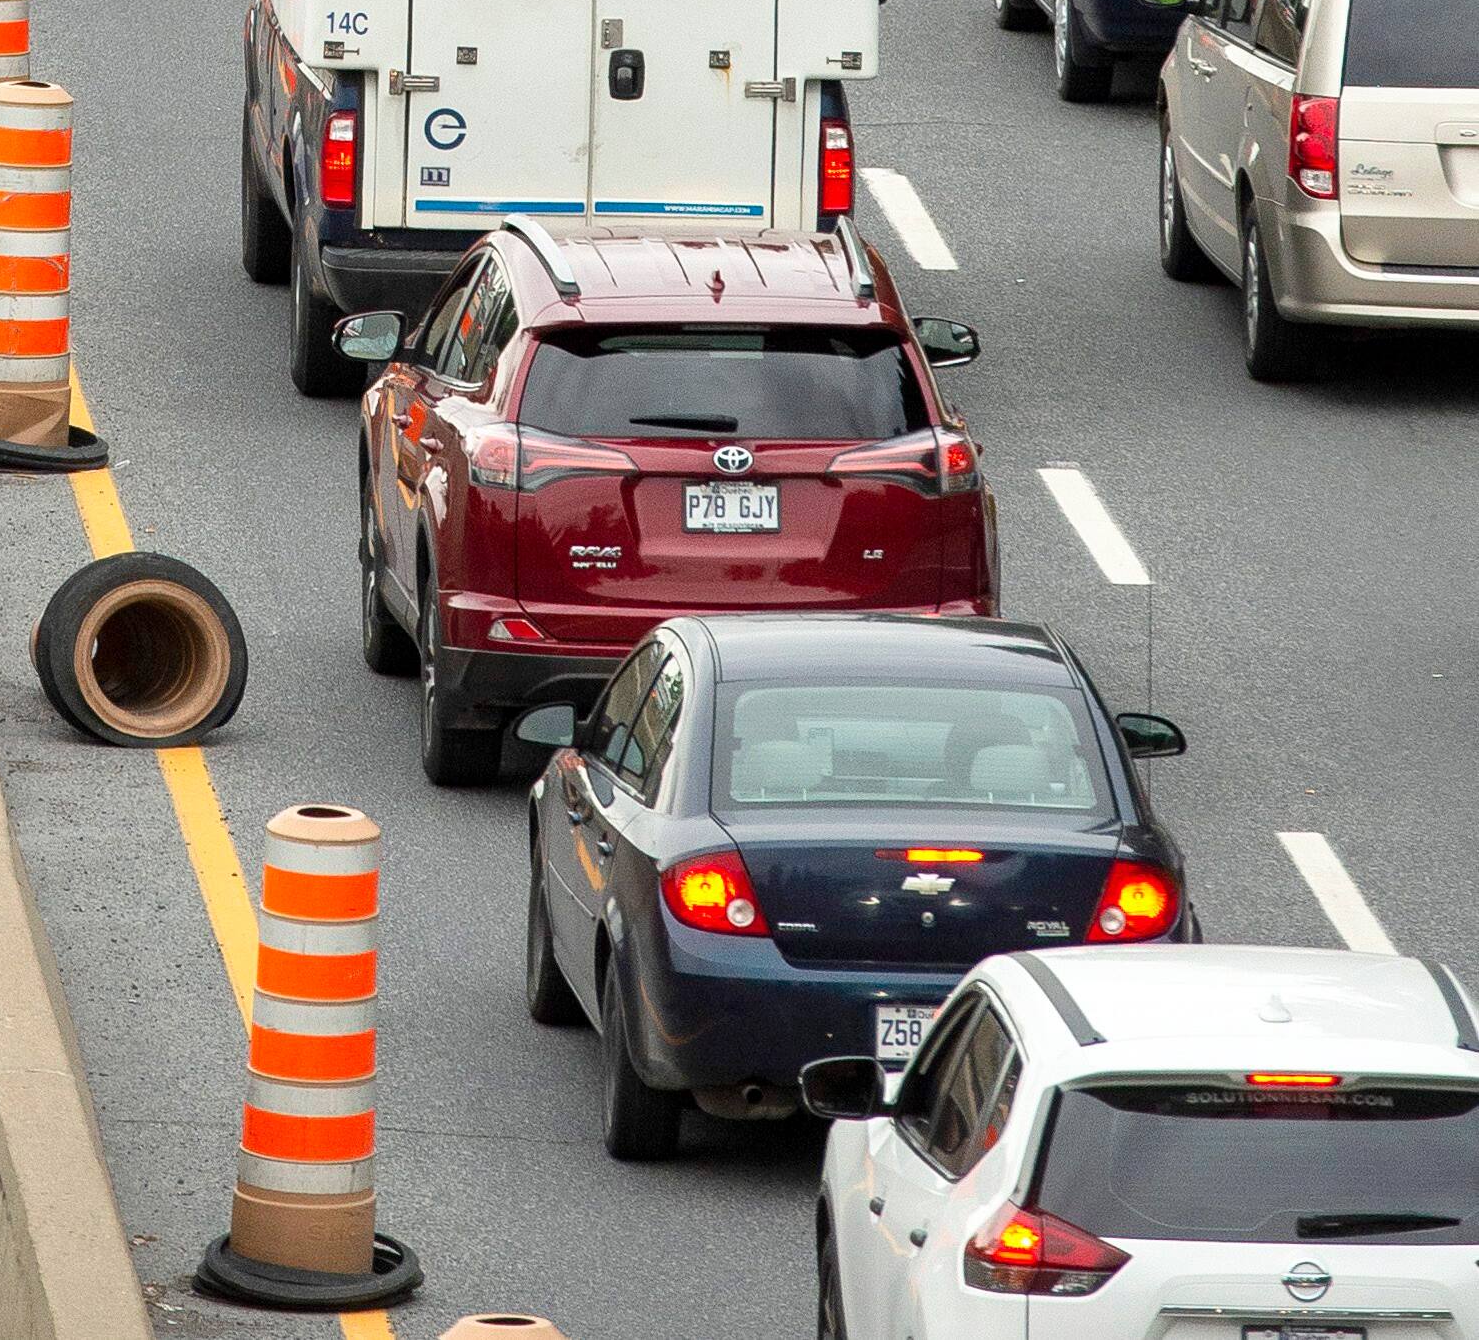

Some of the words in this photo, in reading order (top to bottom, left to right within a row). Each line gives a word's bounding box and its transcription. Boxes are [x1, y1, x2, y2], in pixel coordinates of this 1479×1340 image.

[326, 12, 369, 35] 14C
[689, 495, 725, 519] P78
[739, 495, 775, 519] GJY
[1027, 921, 1070, 930] ROYAL
[881, 1020, 921, 1046] Z58
